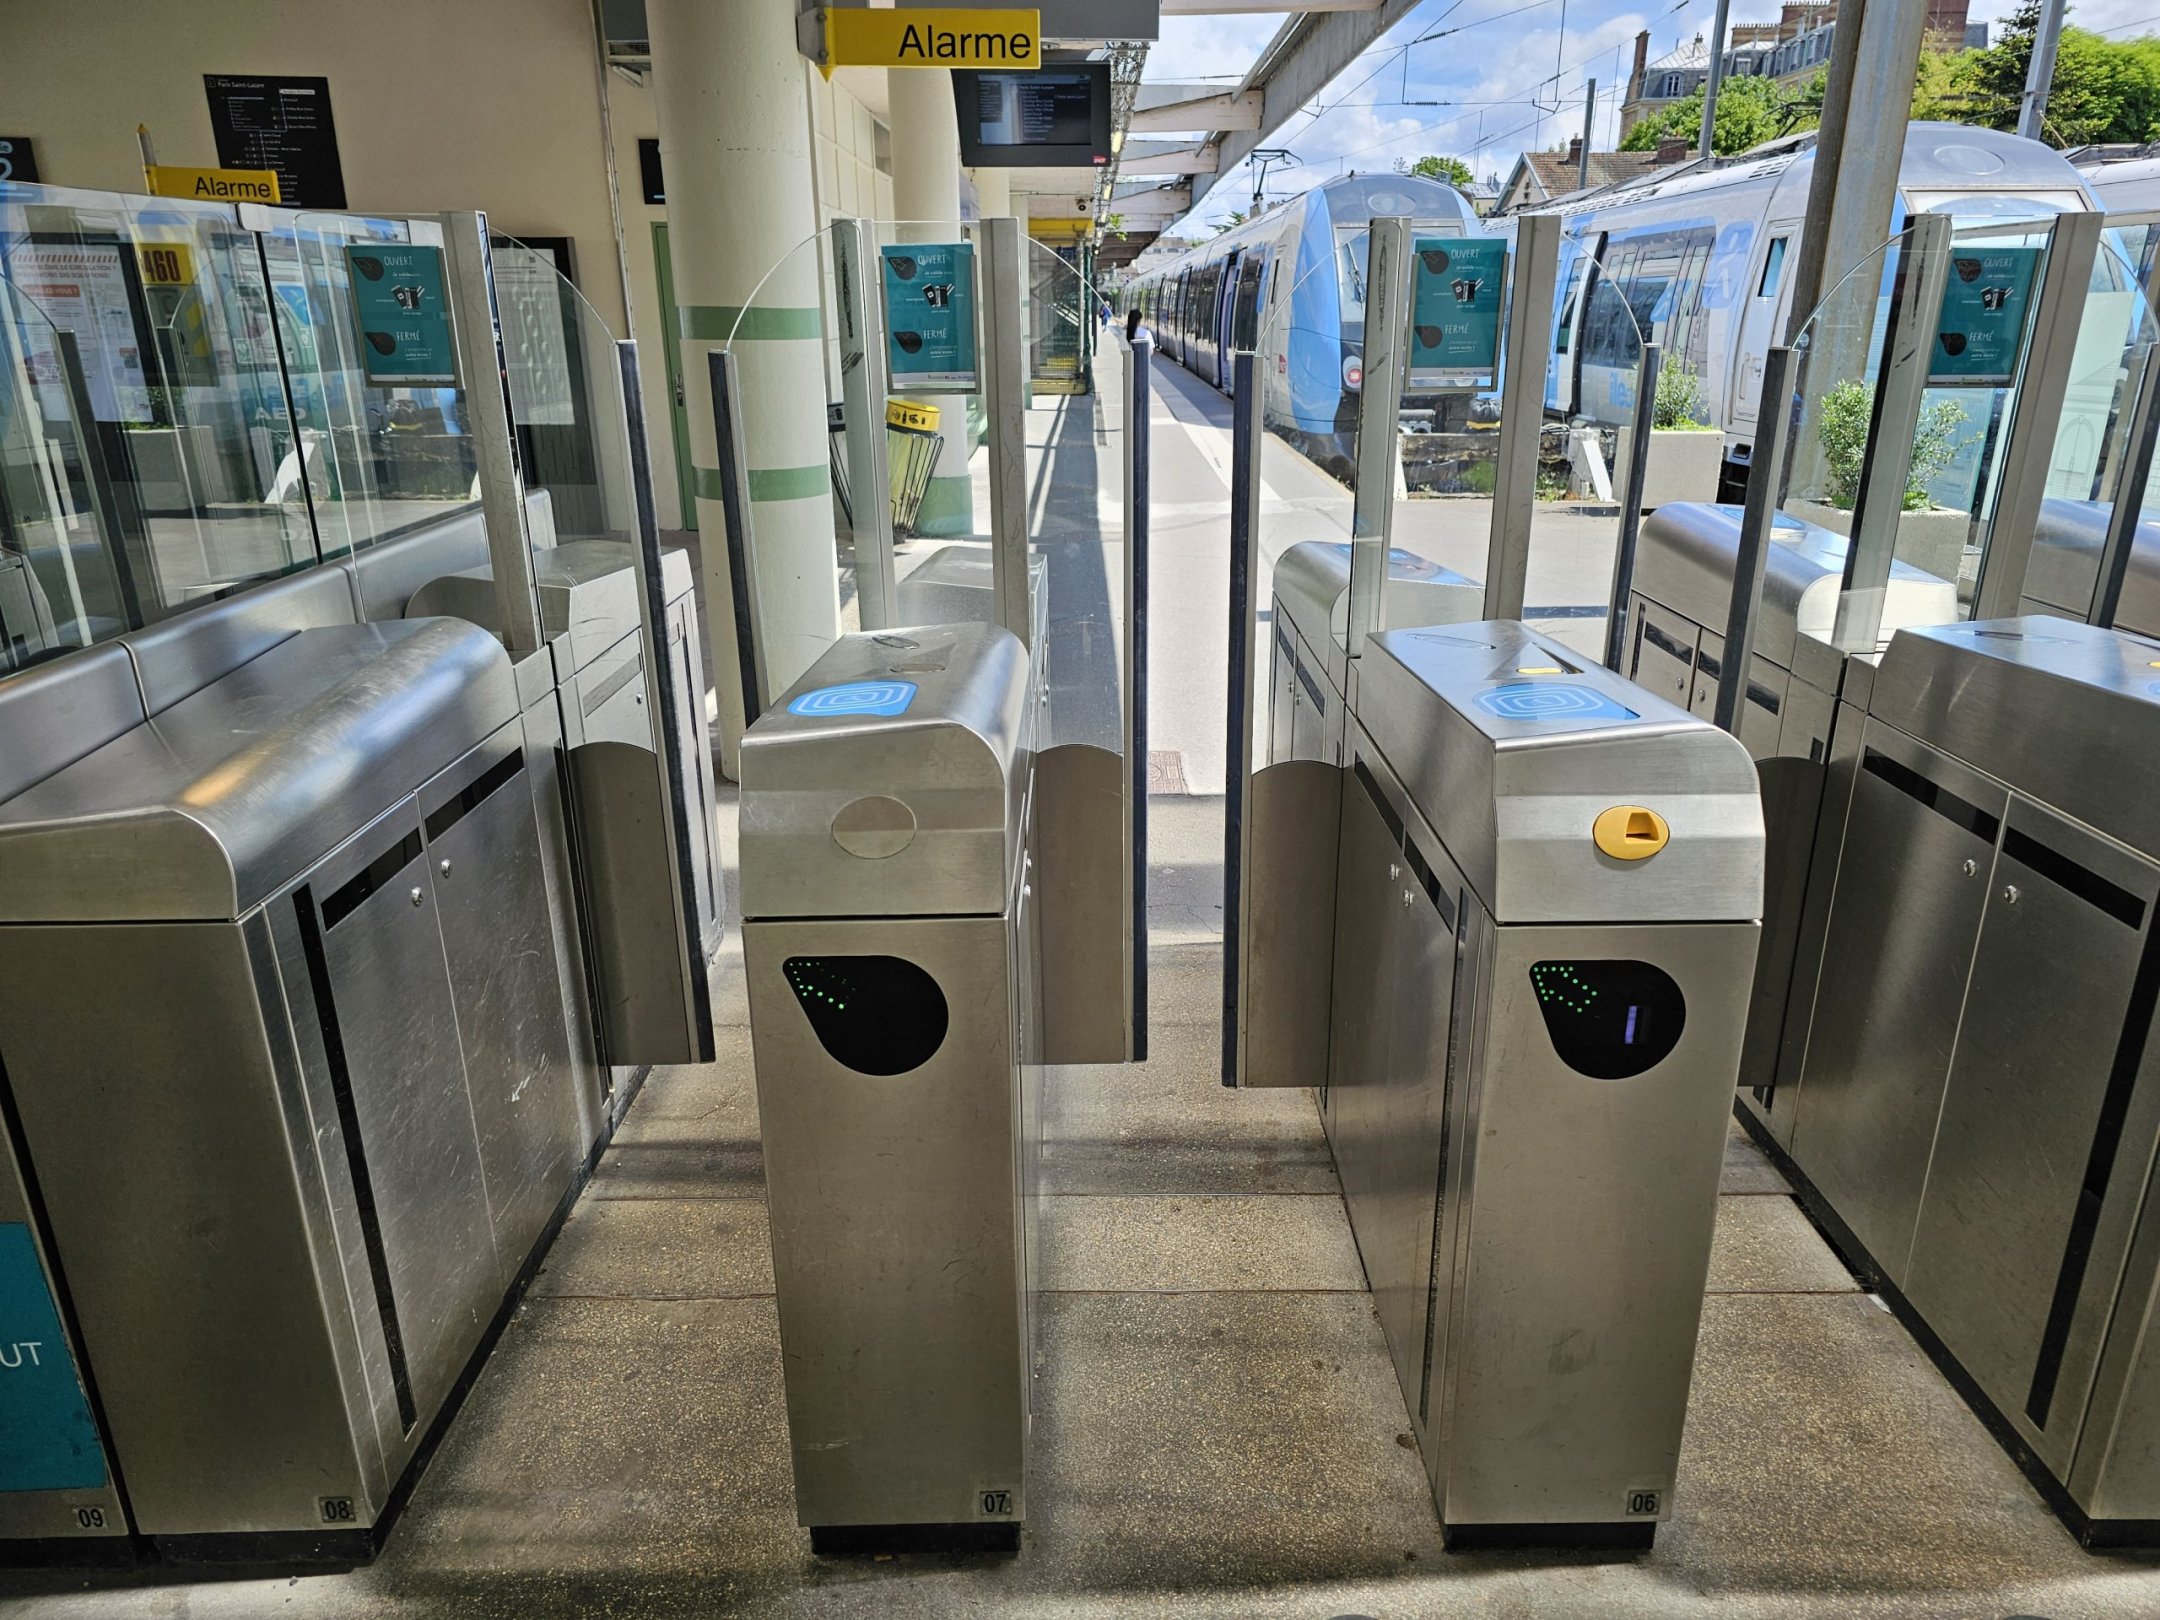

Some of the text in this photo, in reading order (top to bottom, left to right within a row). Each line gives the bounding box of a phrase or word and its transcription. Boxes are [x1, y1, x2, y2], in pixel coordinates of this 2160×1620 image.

[898, 24, 1031, 59] Alarme
[195, 177, 271, 198] Alarme
[918, 254, 946, 265] OUVERT
[1451, 248, 1480, 259] OUVERT
[384, 255, 413, 266] OUVERT
[1984, 257, 2014, 268] OUVERT
[923, 328, 947, 339] FERMÉ
[1445, 322, 1470, 335] FERMÉ
[396, 329, 420, 341] FERMÉ
[1969, 331, 1994, 342] FERMÉ
[984, 1494, 1007, 1513] 07
[1632, 1494, 1655, 1512] 06
[324, 1501, 351, 1520] 08
[78, 1508, 104, 1528] 09
